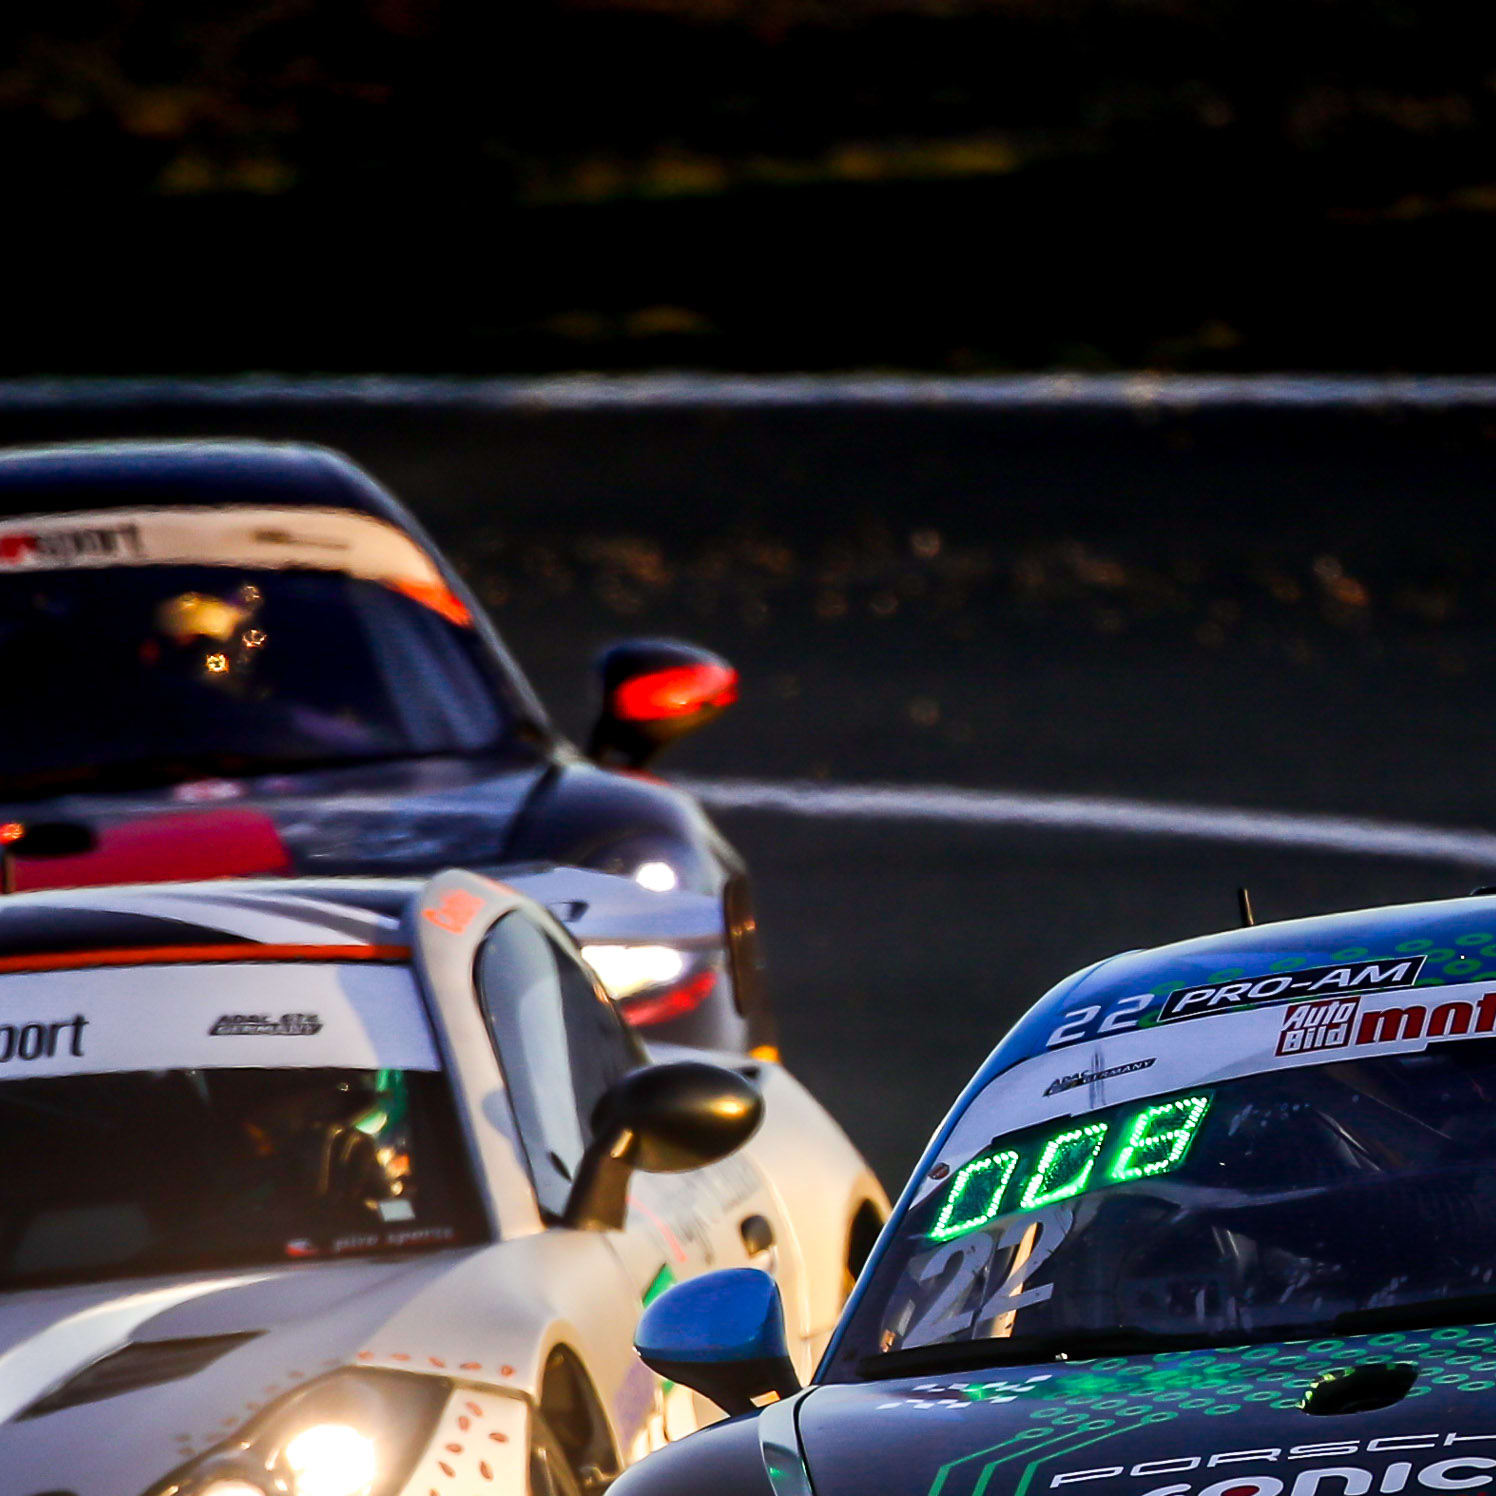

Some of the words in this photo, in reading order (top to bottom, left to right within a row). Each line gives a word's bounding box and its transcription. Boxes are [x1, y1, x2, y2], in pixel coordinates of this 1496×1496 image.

[1045, 992, 1156, 1047] 22
[1171, 961, 1413, 1014] PRO-AM
[1280, 1000, 1354, 1032] Auto
[1281, 1023, 1349, 1055] Bild
[900, 1204, 1055, 1350] 22
